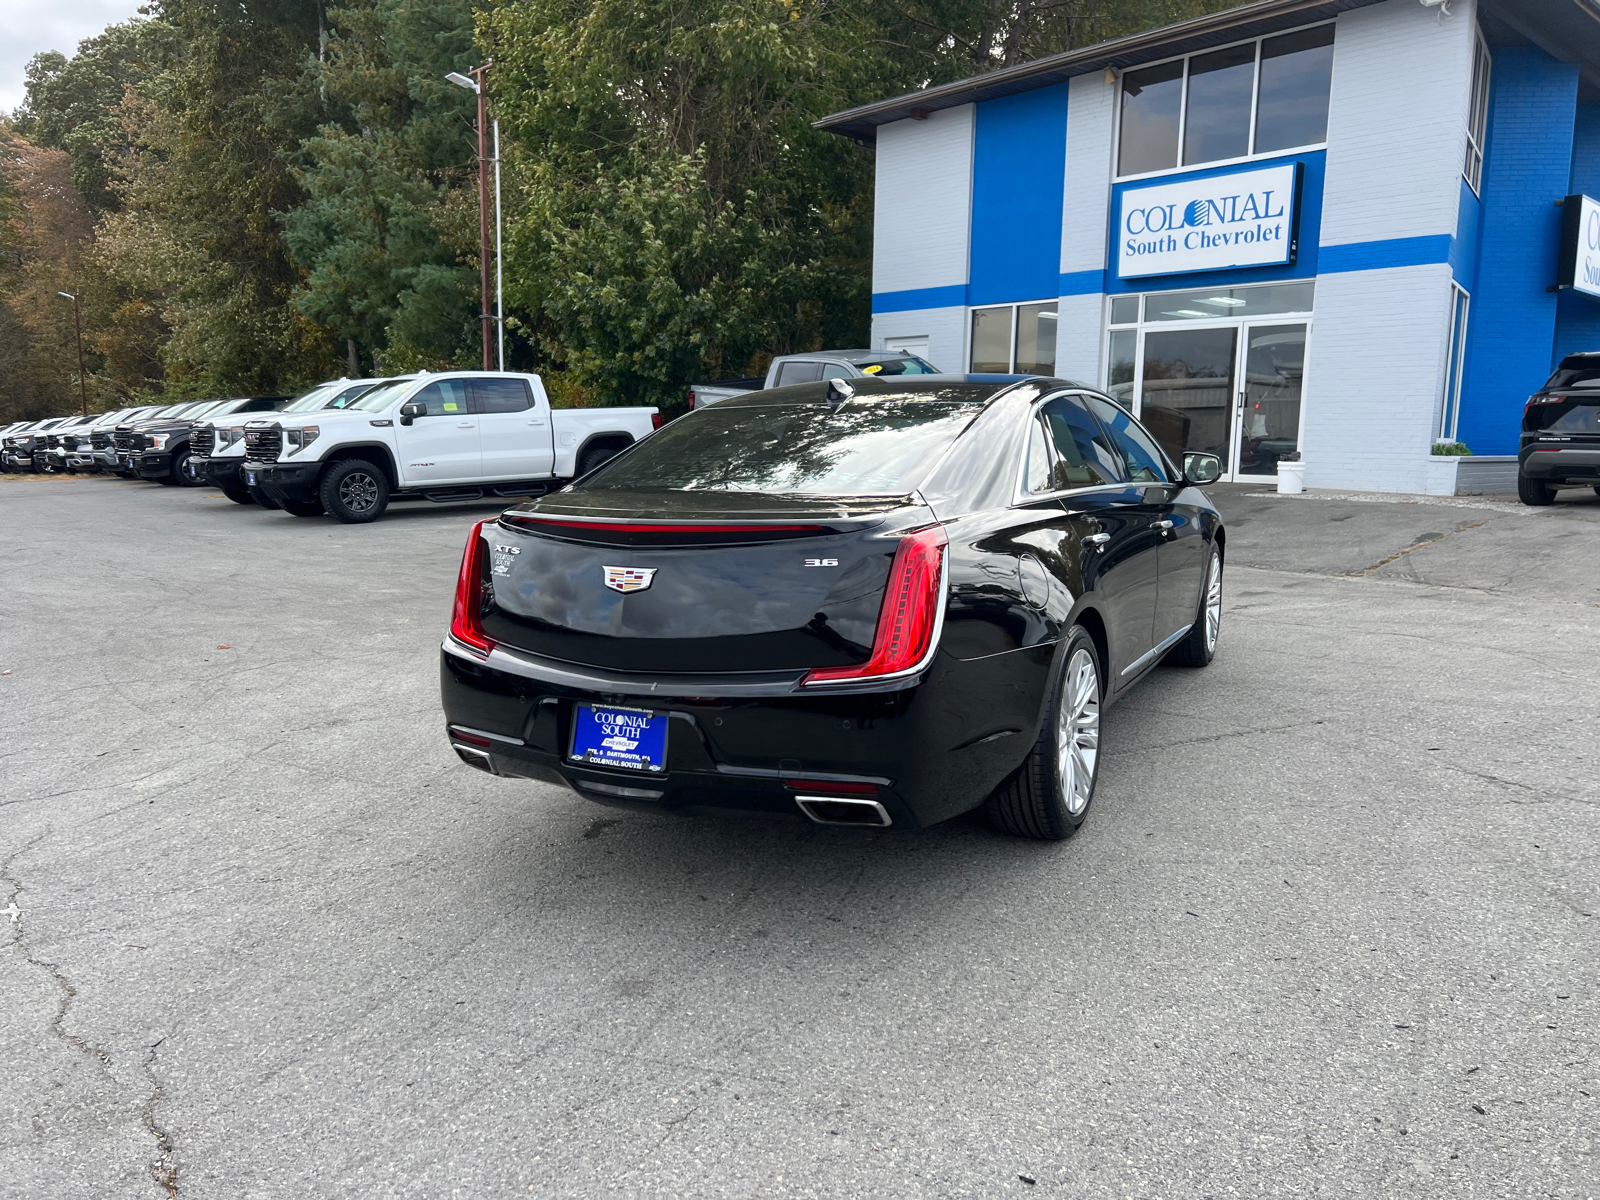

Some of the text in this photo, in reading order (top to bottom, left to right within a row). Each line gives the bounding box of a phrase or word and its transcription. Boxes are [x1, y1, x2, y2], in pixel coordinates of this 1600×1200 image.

[1126, 190, 1284, 235] COLONIAL
[1125, 223, 1282, 256] South Chevrolet
[494, 544, 521, 555] XTS
[594, 712, 650, 728] COLONIAL
[601, 724, 640, 738] SOUTH
[605, 739, 635, 748] CHEVROLET
[606, 750, 641, 761] DARTMOUTH,
[589, 756, 642, 769] COLONIAL SOUTH
